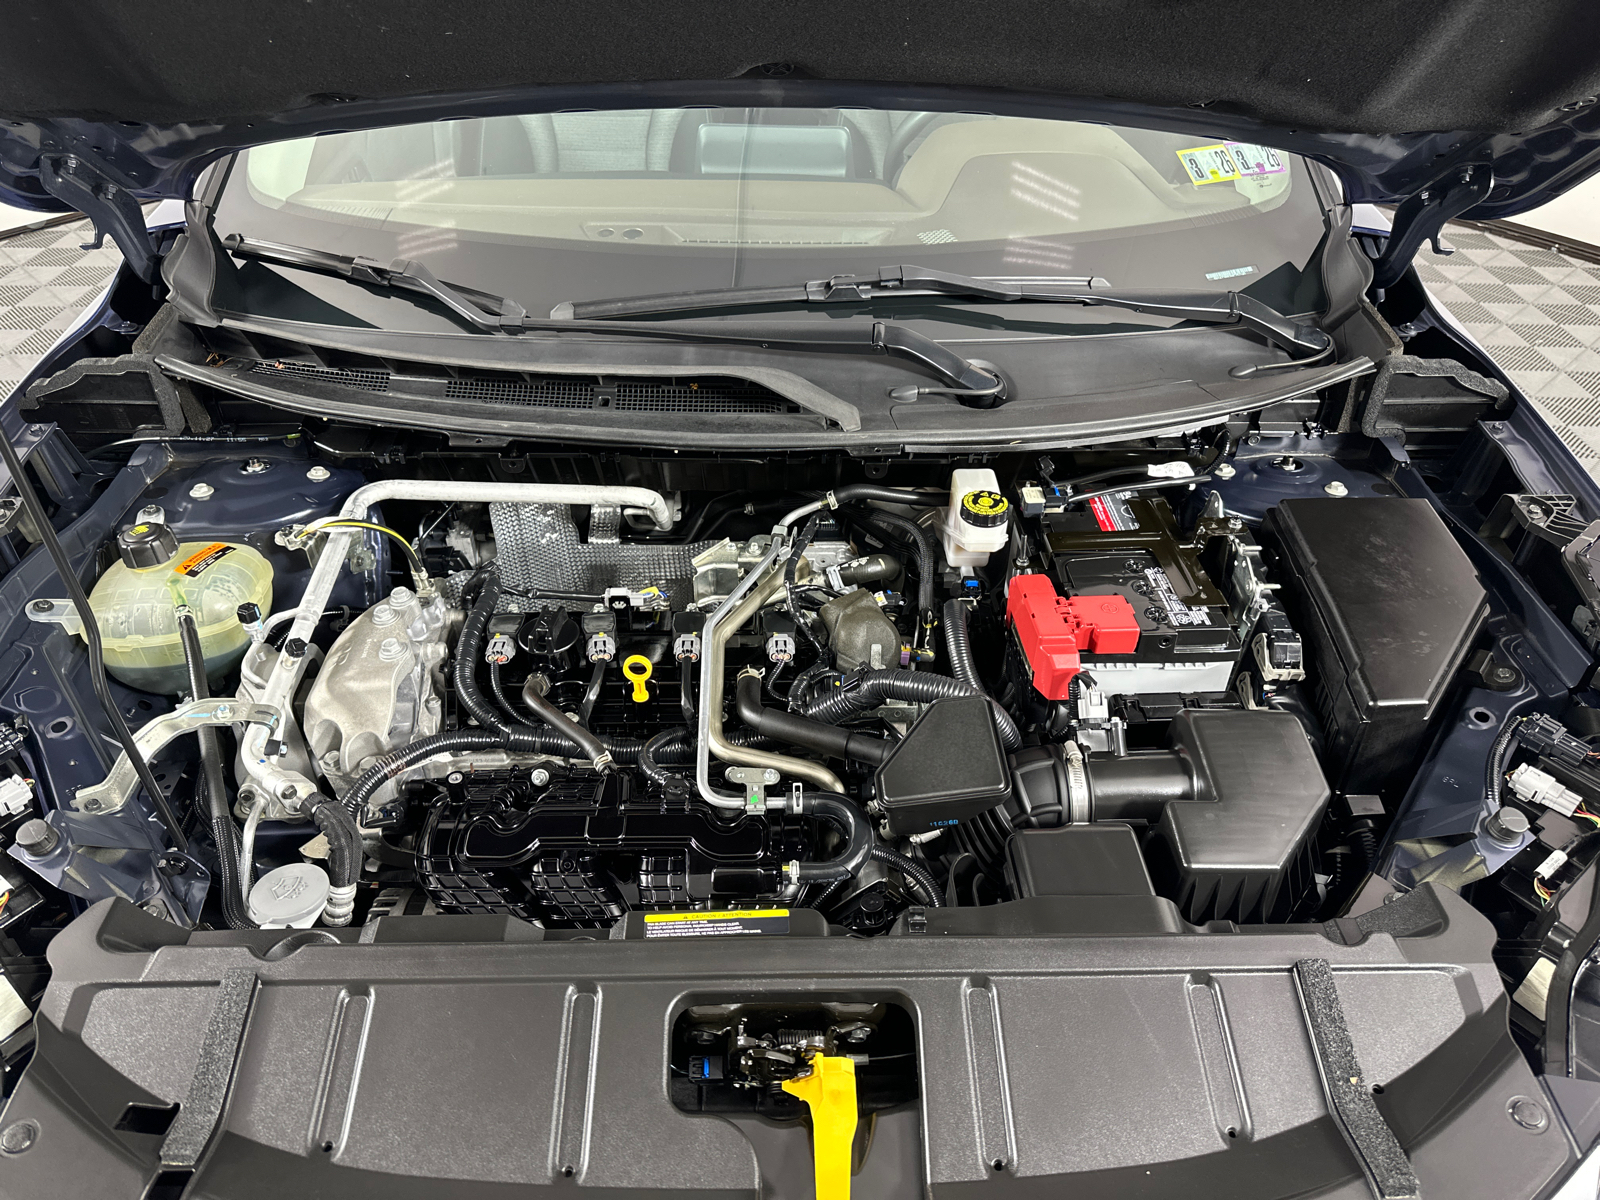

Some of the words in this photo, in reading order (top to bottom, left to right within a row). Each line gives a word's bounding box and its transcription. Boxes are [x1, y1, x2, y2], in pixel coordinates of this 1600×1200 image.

[1188, 158, 1205, 179] 3
[1214, 150, 1236, 174] 26
[1234, 150, 1251, 170] 3
